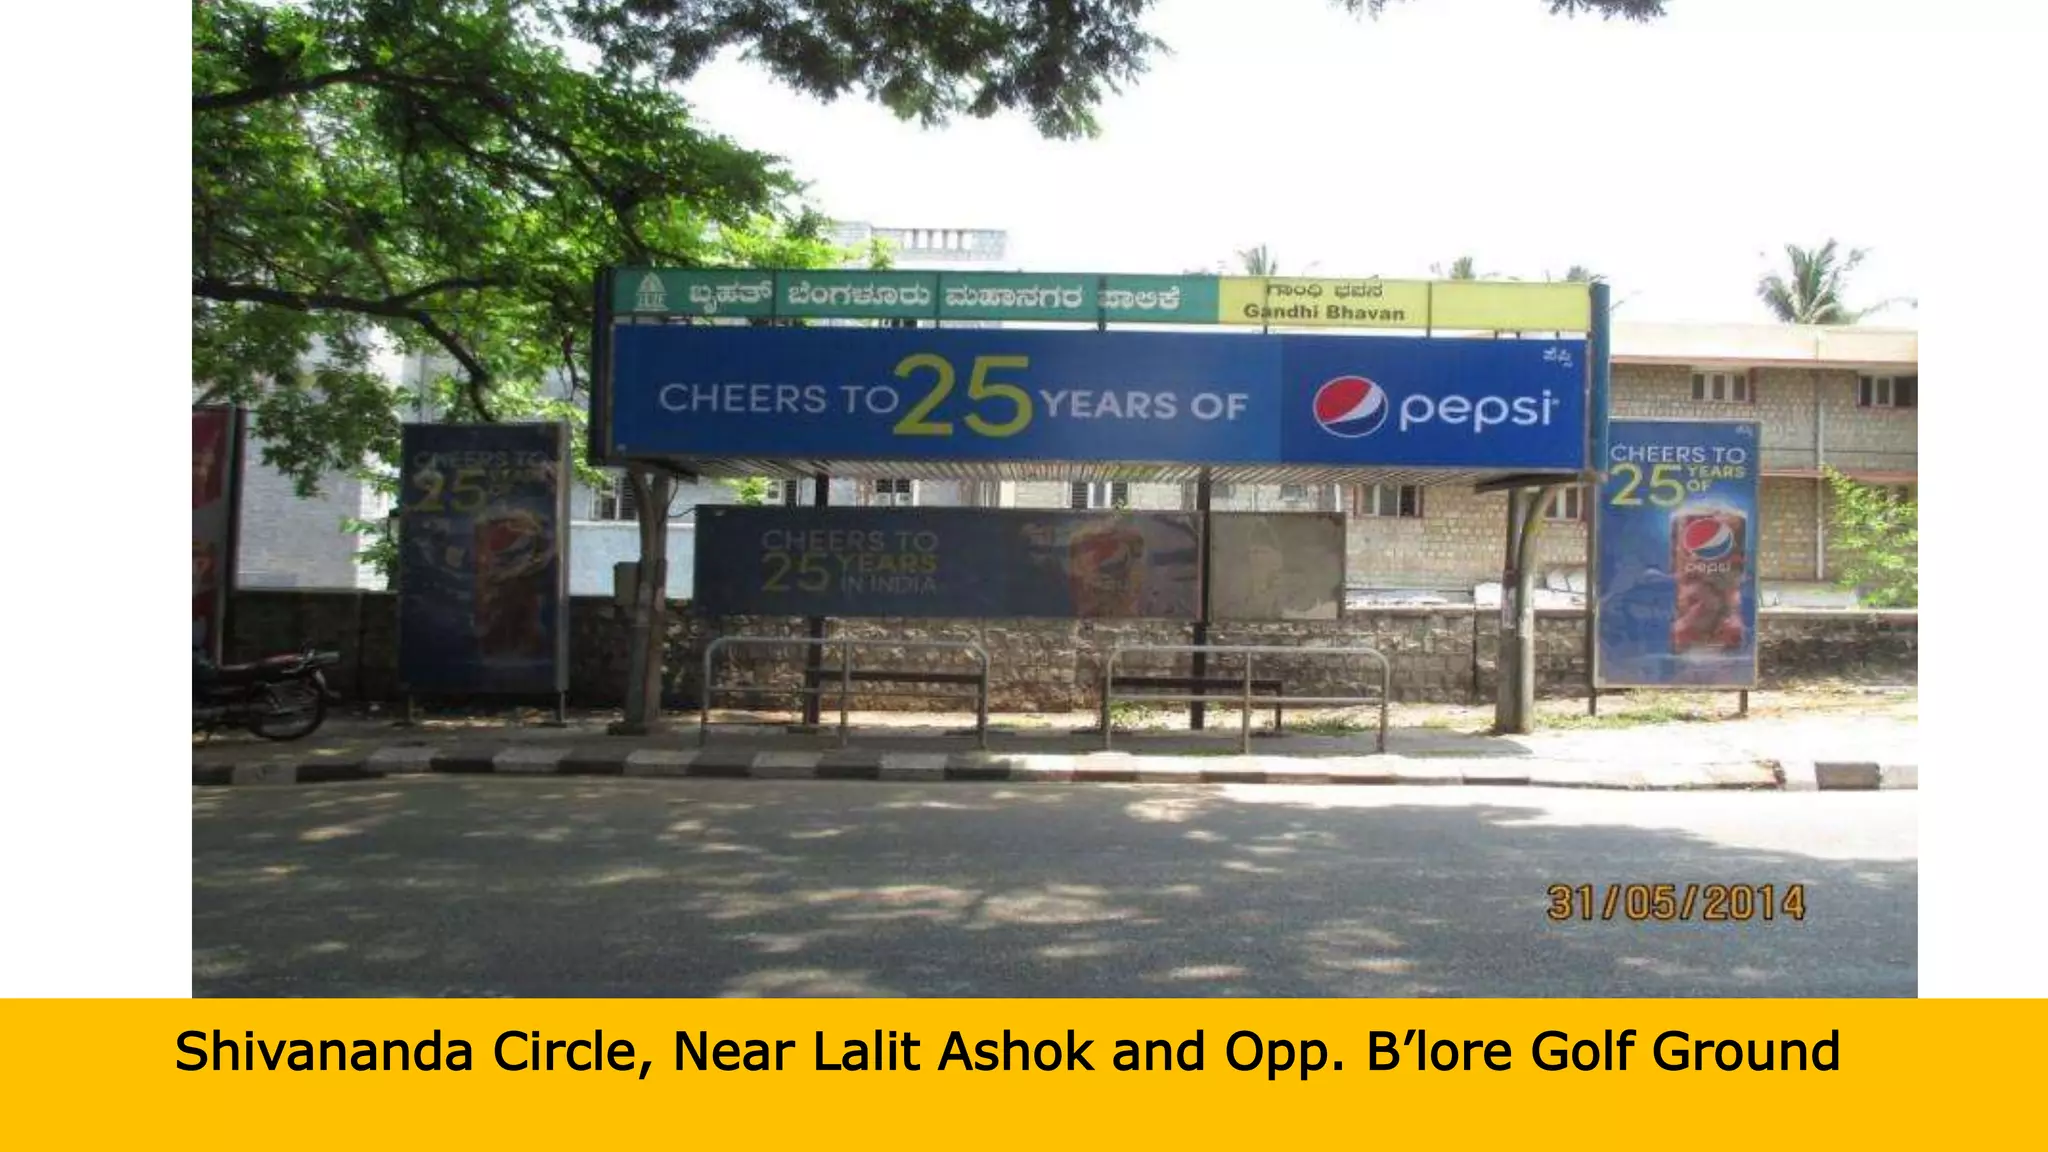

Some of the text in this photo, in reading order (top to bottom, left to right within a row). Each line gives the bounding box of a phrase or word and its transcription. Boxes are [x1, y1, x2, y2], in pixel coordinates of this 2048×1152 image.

[689, 281, 773, 314] ಬೃಹತ್
[788, 280, 931, 307] ಬೆಂಗಳೂರು
[945, 283, 1082, 309] ಮಹಾನಗರ
[1334, 281, 1383, 299] ಭವನ
[1243, 303, 1406, 321] Gandhi Bhavan
[659, 353, 1249, 438] CHEERS TO 25 YEARS OF
[1400, 389, 1555, 433] pepsi
[1610, 443, 1747, 465] CHEERS TO
[1610, 463, 1745, 506] 25 YEARS
[1686, 479, 1712, 492] OF
[762, 530, 939, 553] CHEERS TO
[761, 551, 939, 592] 25 YEARS
[841, 575, 937, 594] IN INDIA
